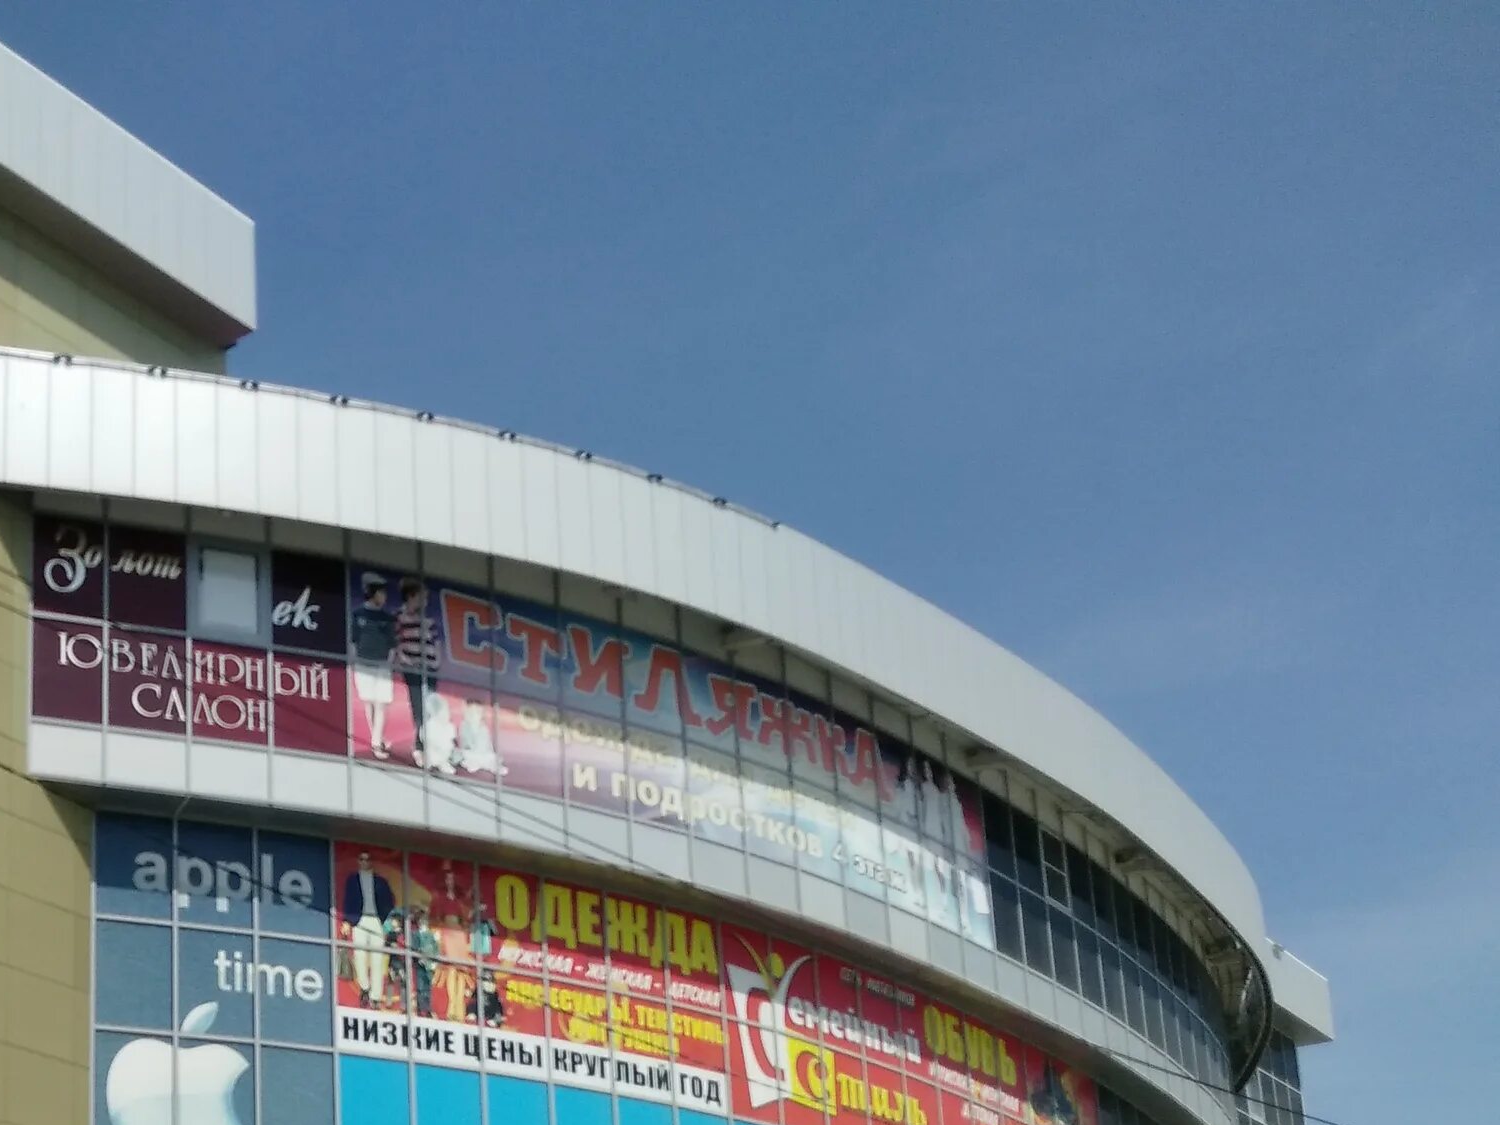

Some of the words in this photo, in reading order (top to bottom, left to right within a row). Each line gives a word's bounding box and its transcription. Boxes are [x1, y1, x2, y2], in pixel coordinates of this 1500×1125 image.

[57, 631, 331, 701] ЮВЕЛИРНЫЙ
[440, 588, 897, 801] СТИЛЯЖКА
[131, 683, 268, 733] САЛОН
[132, 849, 314, 912] apple
[494, 874, 719, 976] ОДЕЖДА
[213, 949, 325, 1002] time
[342, 1015, 454, 1054] НИЗКИЕ
[463, 1032, 541, 1069] ЦЕНЫ
[553, 1047, 671, 1092] КРУГЛЫЙ
[679, 1073, 722, 1107] ГОД
[923, 1004, 1017, 1087] ОБУВЬ
